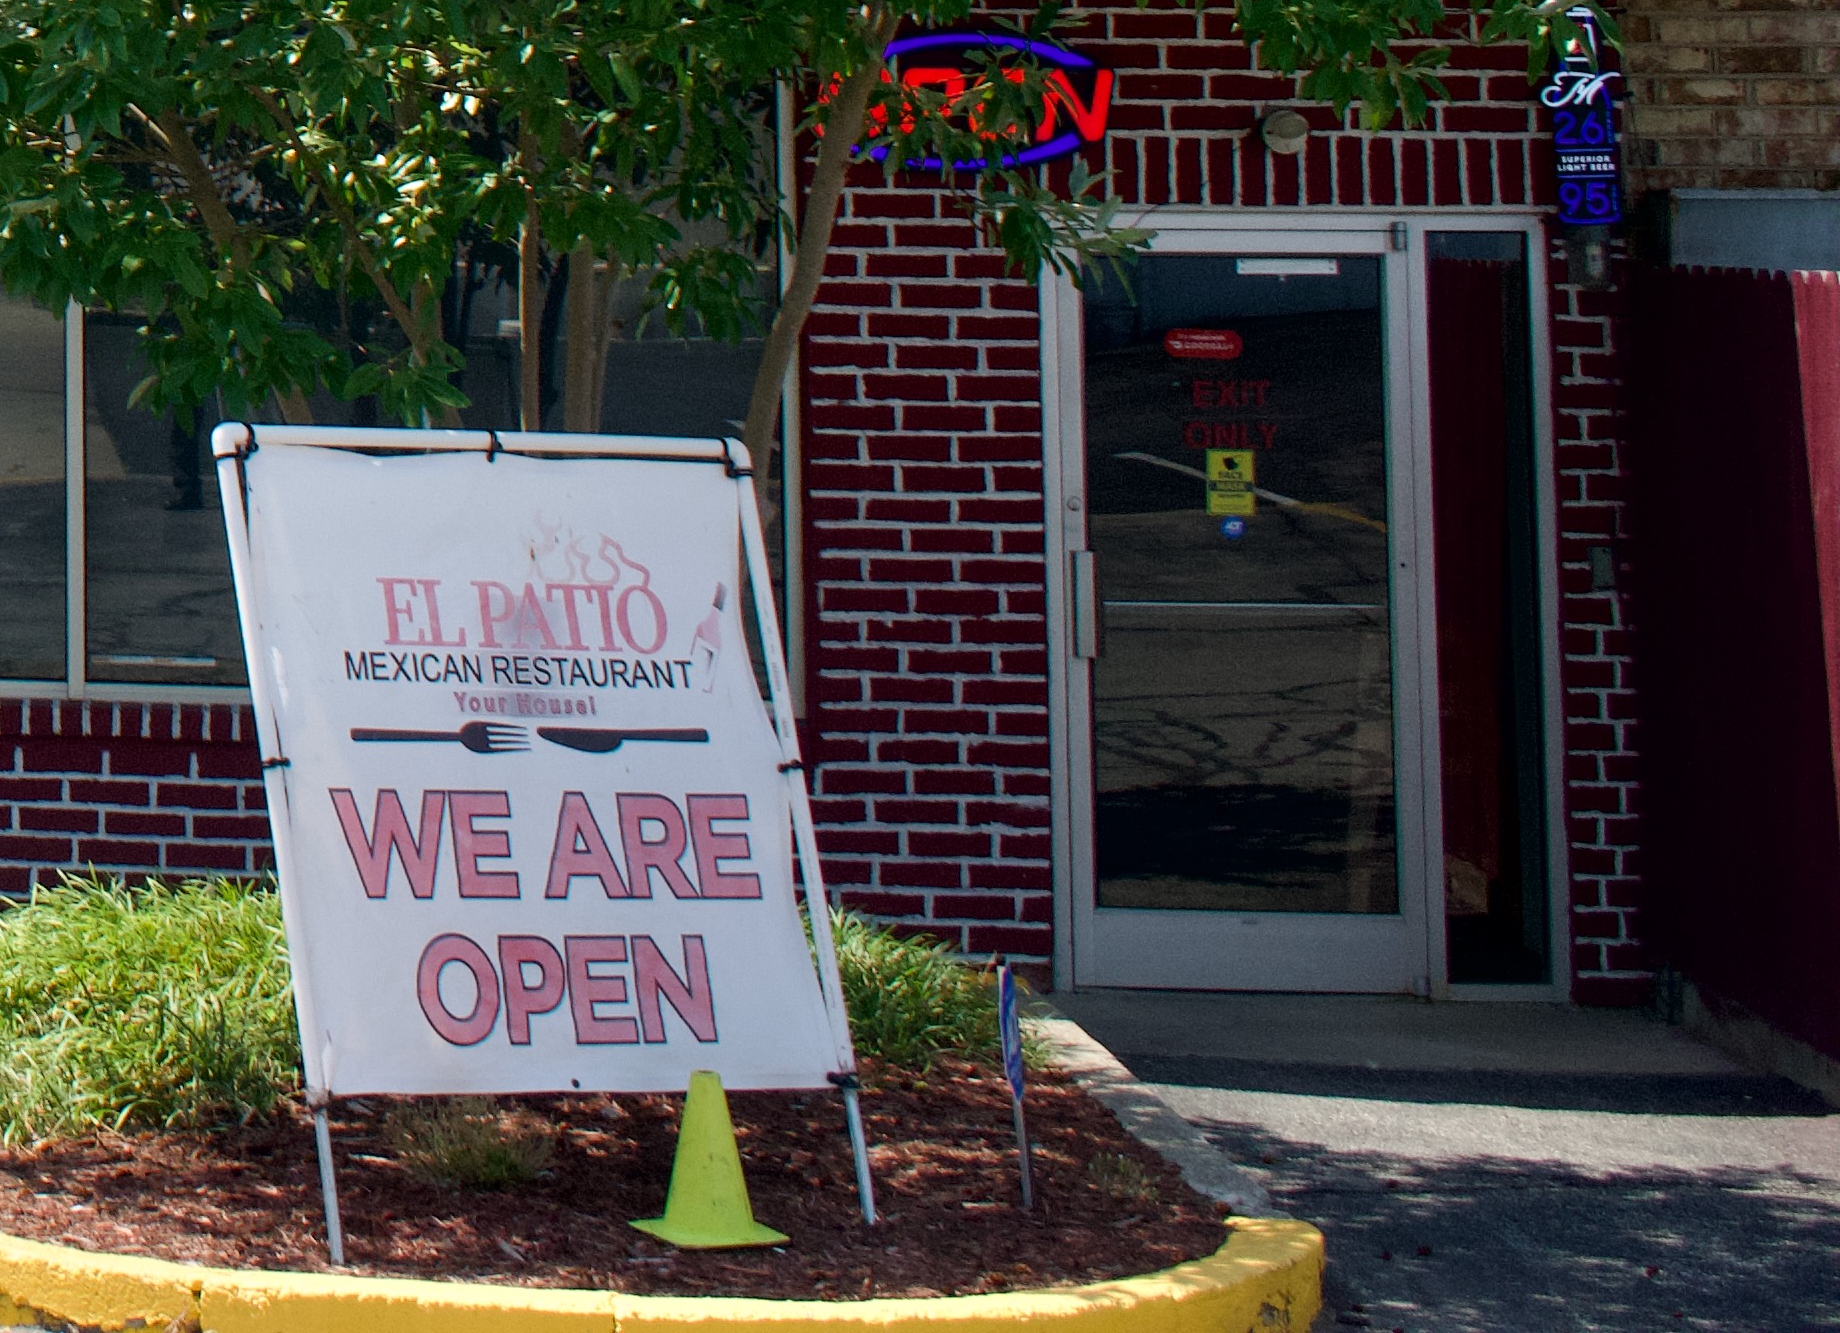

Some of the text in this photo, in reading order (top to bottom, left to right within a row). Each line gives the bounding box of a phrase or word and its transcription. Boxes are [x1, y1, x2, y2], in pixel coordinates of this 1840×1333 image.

[1557, 163, 1616, 172] LIGHT BEER
[1561, 155, 1611, 164] SUPERIOR
[1559, 183, 1611, 215] 95
[1192, 379, 1271, 408] EXIT
[1183, 421, 1279, 450] ONLY
[376, 577, 668, 655] EL PATIO
[344, 651, 693, 690] MEXICAN RESTAURANT
[453, 692, 598, 716] Your House!
[328, 787, 763, 900] WE ARE
[416, 932, 719, 1047] OPEN
